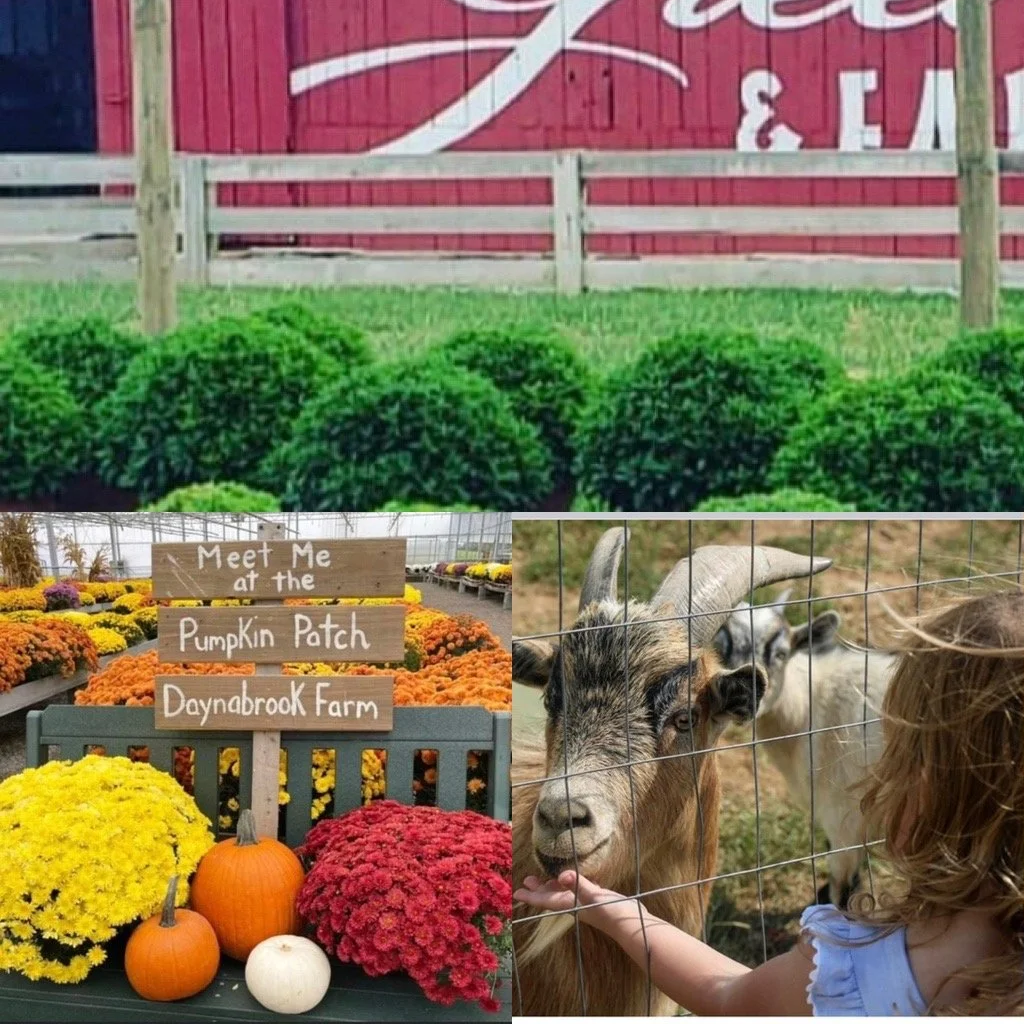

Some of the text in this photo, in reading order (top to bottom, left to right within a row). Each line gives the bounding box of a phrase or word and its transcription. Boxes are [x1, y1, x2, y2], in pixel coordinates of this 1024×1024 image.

[736, 70, 802, 152] &
[197, 541, 332, 570] Meet Me
[233, 570, 316, 593] at the
[294, 611, 371, 650] Patch
[315, 682, 378, 719] Farm
